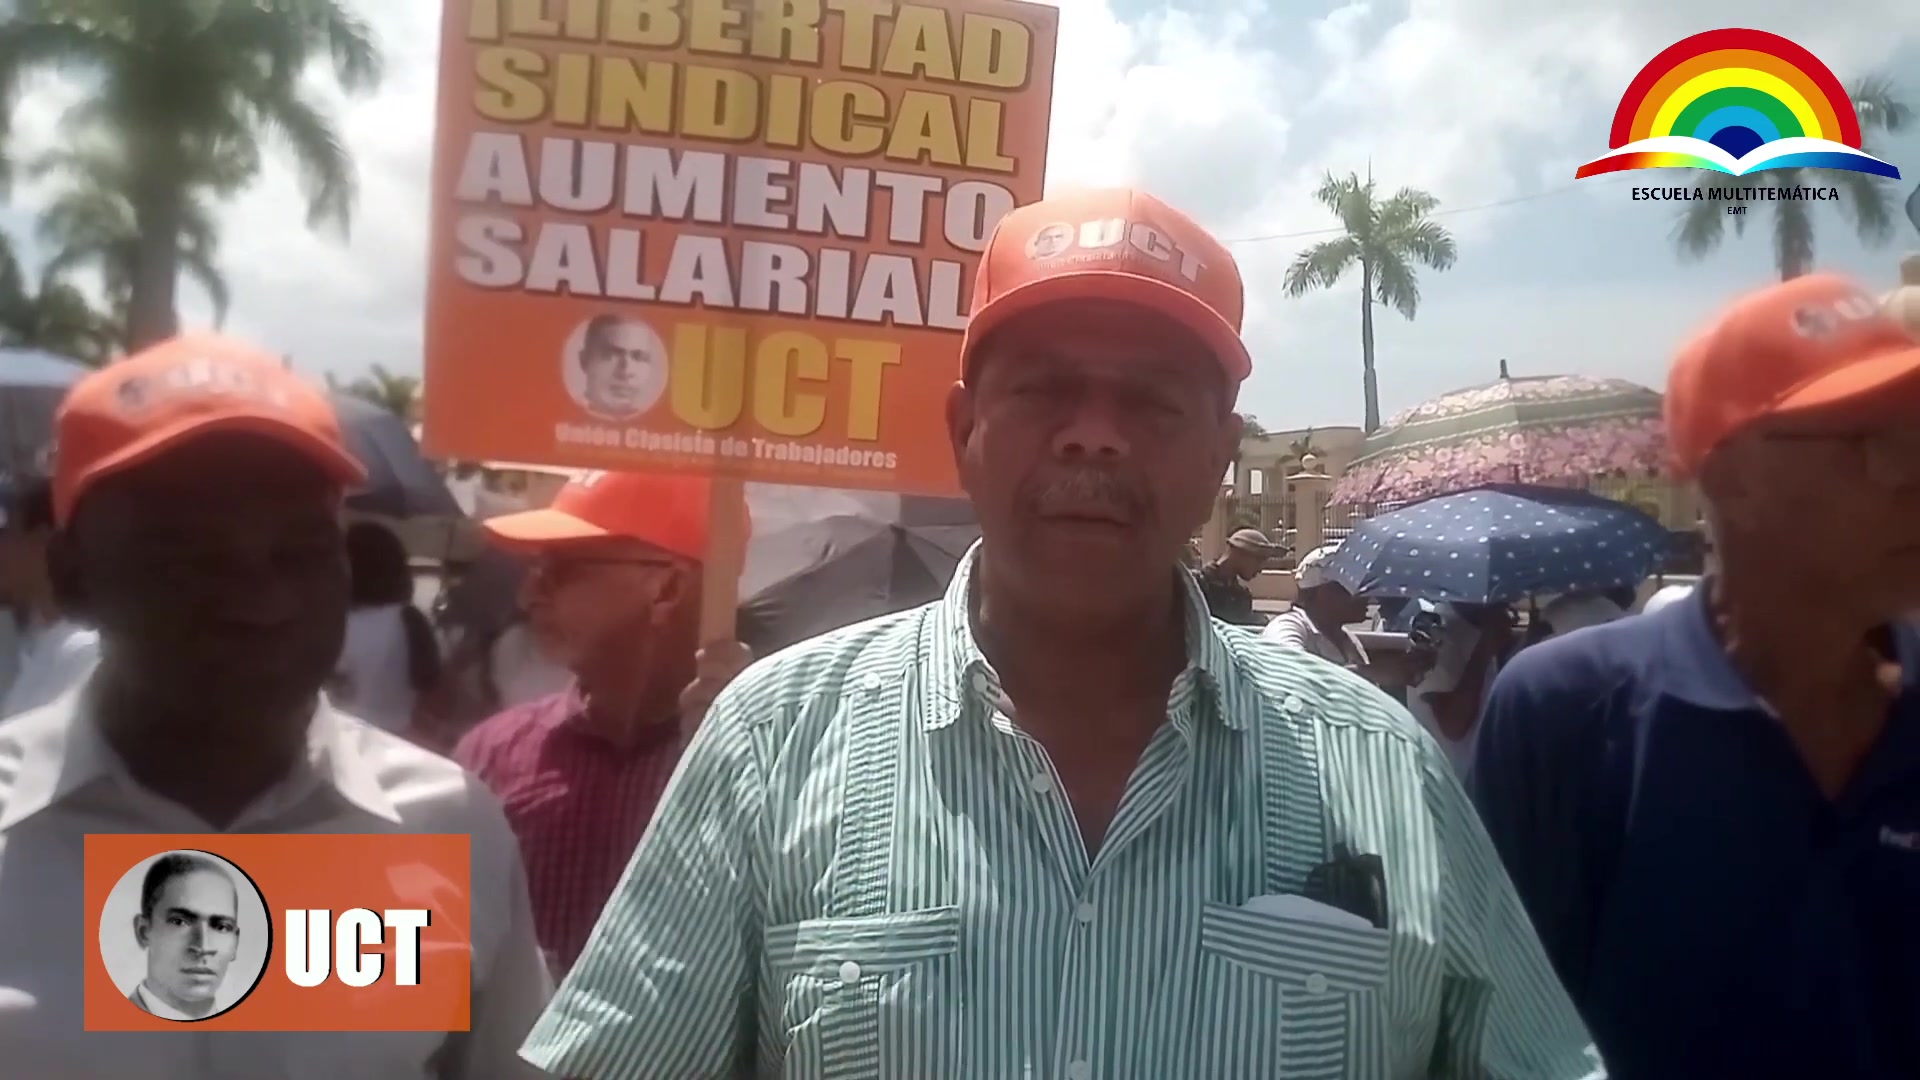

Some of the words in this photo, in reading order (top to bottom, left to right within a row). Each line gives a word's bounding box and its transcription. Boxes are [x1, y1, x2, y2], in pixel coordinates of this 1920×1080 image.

[472, 47, 1018, 173] SINDICAL
[455, 131, 1016, 253] AUMENTO
[1078, 217, 1207, 282] UCT
[454, 215, 970, 331] SALARIAL
[669, 322, 903, 442] UCT
[720, 436, 748, 458] de
[752, 438, 898, 470] Trabajadores
